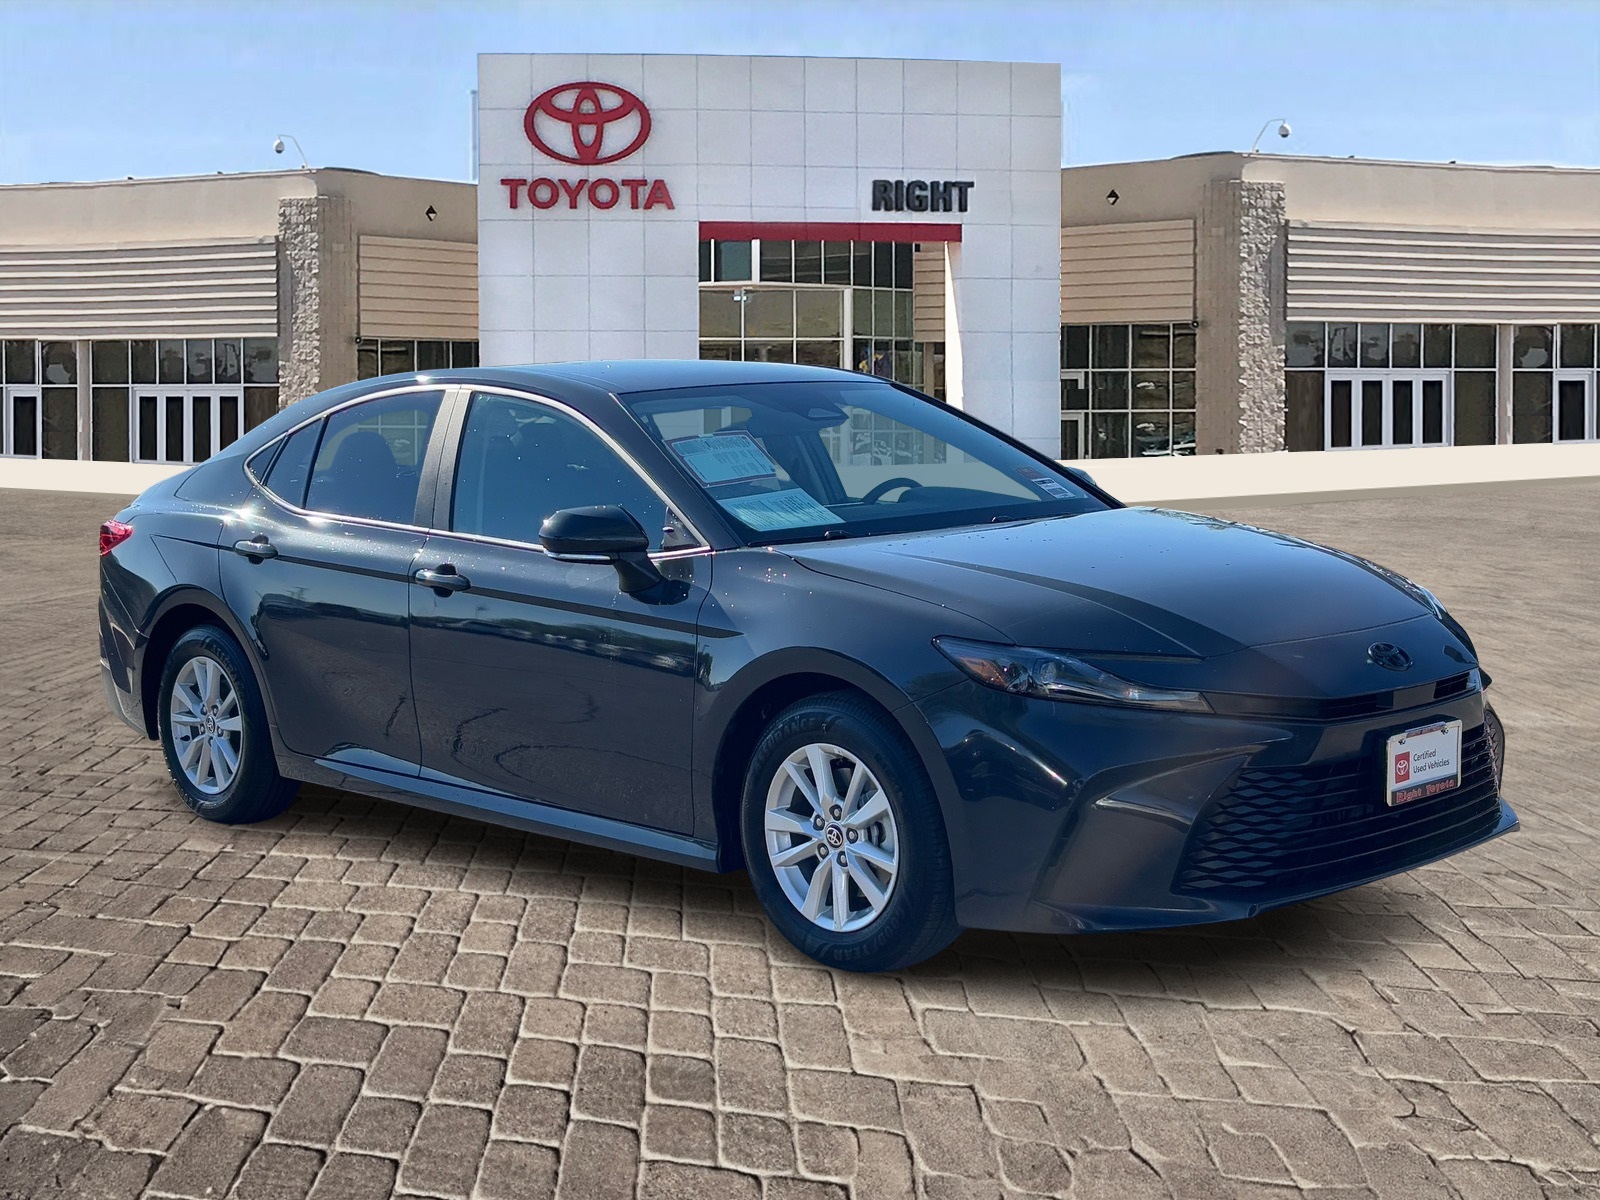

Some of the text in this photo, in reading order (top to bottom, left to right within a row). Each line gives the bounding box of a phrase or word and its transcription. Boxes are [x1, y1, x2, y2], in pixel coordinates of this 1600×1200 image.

[500, 178, 675, 210] TOYOTA
[872, 179, 975, 212] RIGHT
[1413, 748, 1436, 761] Certified
[1413, 758, 1449, 773] Used Vehicles
[1396, 780, 1454, 803] Right Toyota
